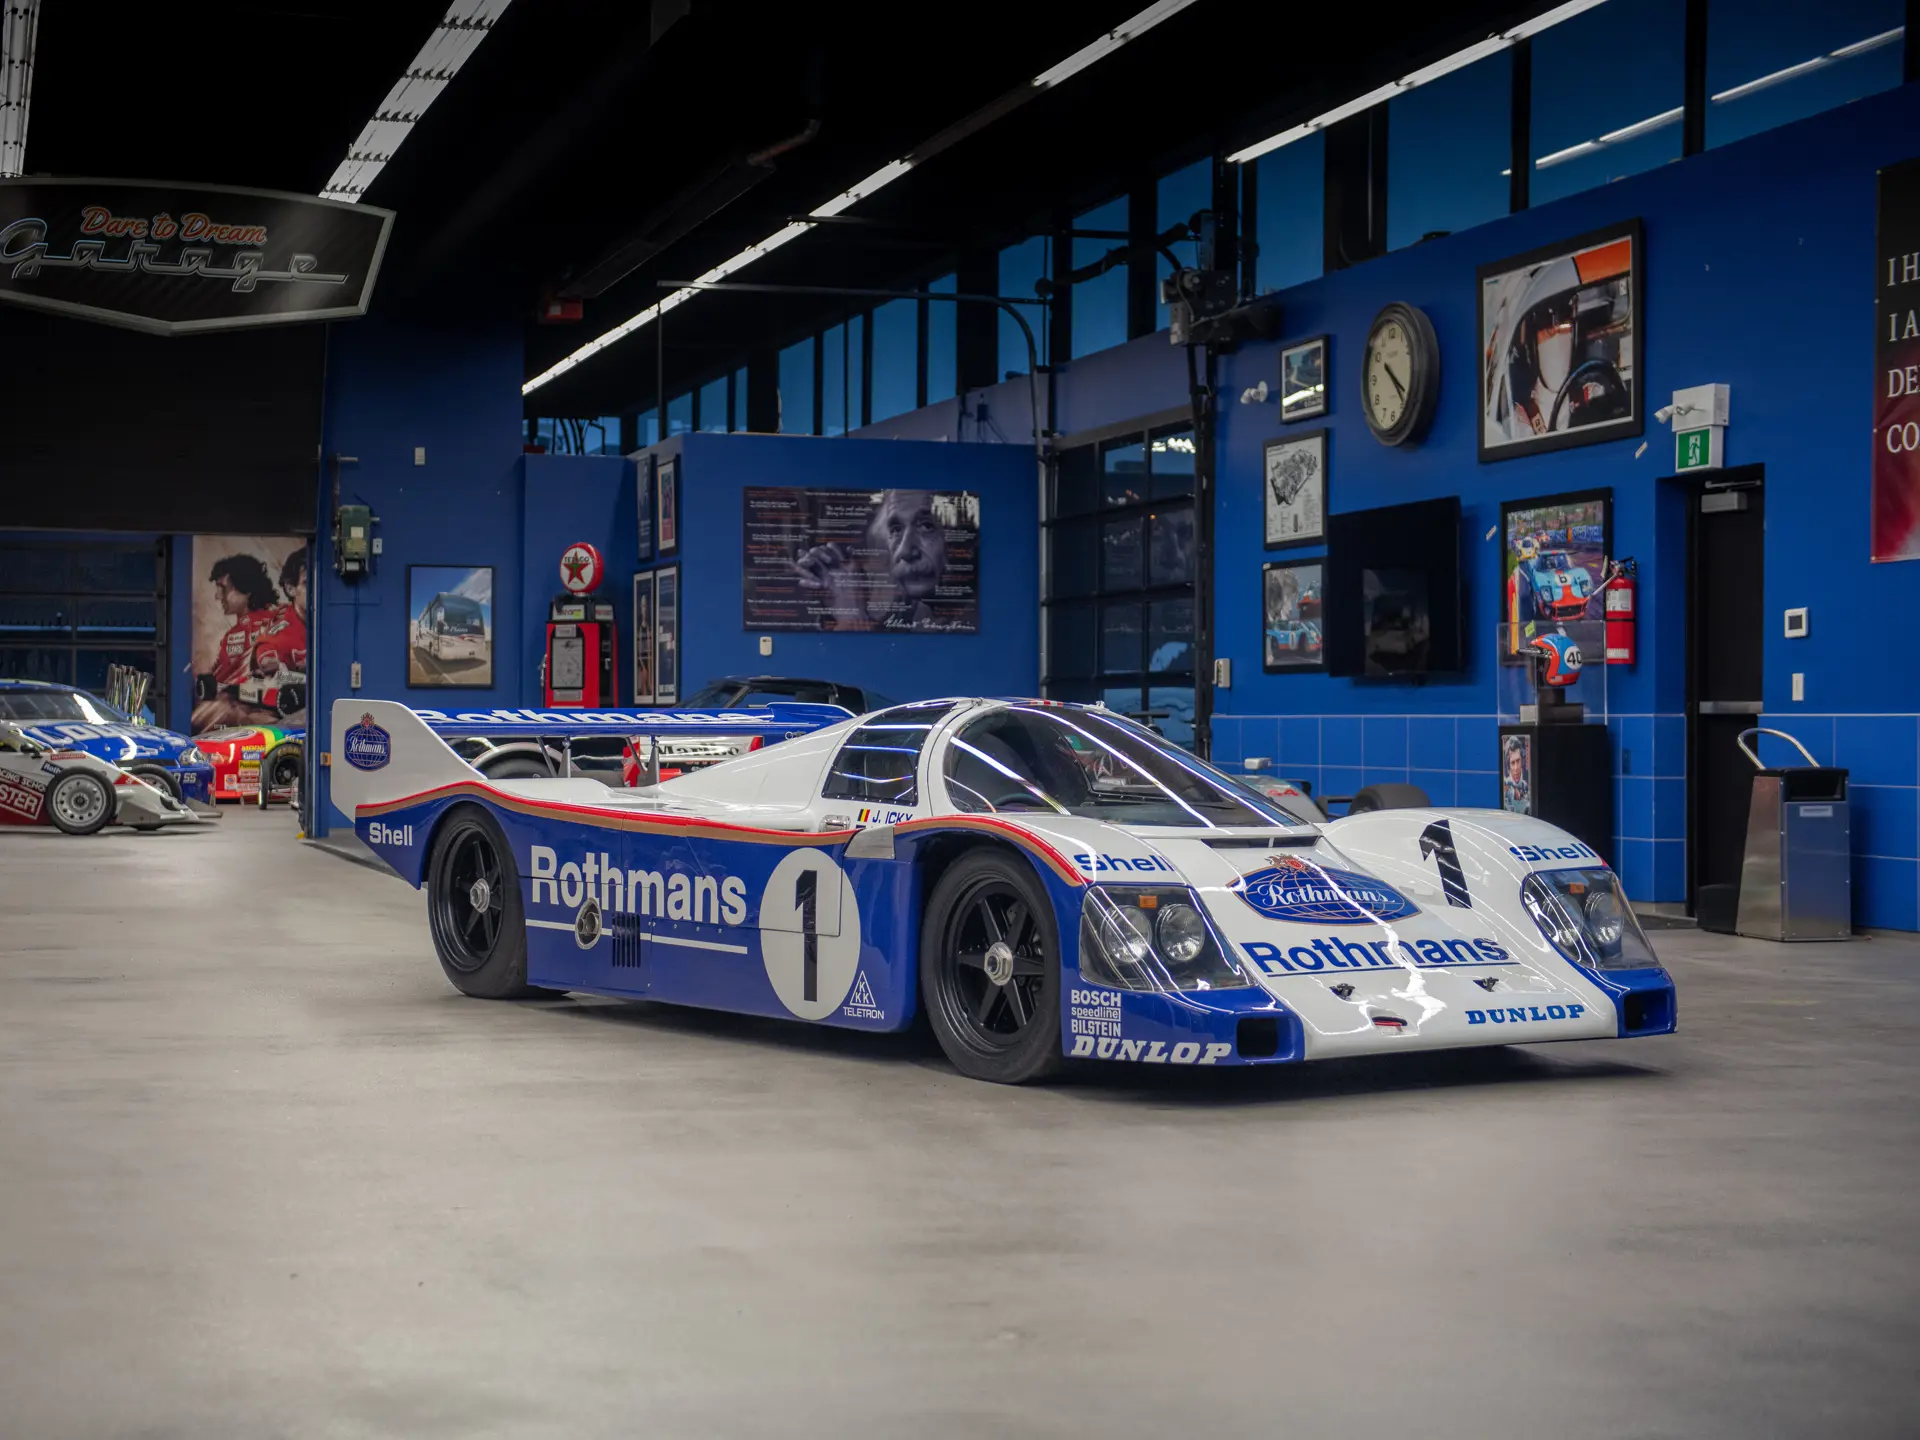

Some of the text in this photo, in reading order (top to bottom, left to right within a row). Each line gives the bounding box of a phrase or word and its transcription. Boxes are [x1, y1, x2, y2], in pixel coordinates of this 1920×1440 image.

[81, 206, 267, 245] Dare to Dream
[0, 217, 348, 292] Garage
[1887, 257, 1896, 287] I
[1889, 313, 1898, 342] I
[1887, 365, 1920, 398] DE
[1567, 650, 1582, 665] 40
[349, 736, 386, 755] Rothmans
[872, 810, 881, 824] J.
[368, 822, 413, 847] Shell
[1073, 853, 1176, 872] Shell
[1418, 818, 1473, 910] 1
[1508, 843, 1599, 862] Shell
[531, 844, 747, 927] Rothmans
[1256, 883, 1396, 907] Rothmans
[794, 869, 818, 1003] 1
[1239, 936, 1511, 974] Rothmans
[1071, 989, 1121, 1007] BOSCH
[843, 1006, 885, 1020] TELETRON
[1071, 1006, 1119, 1020] speedline
[1464, 1003, 1586, 1025] DUNLOP
[1071, 1018, 1121, 1037] BILSTEIN
[1070, 1035, 1232, 1065] DUNLOP
